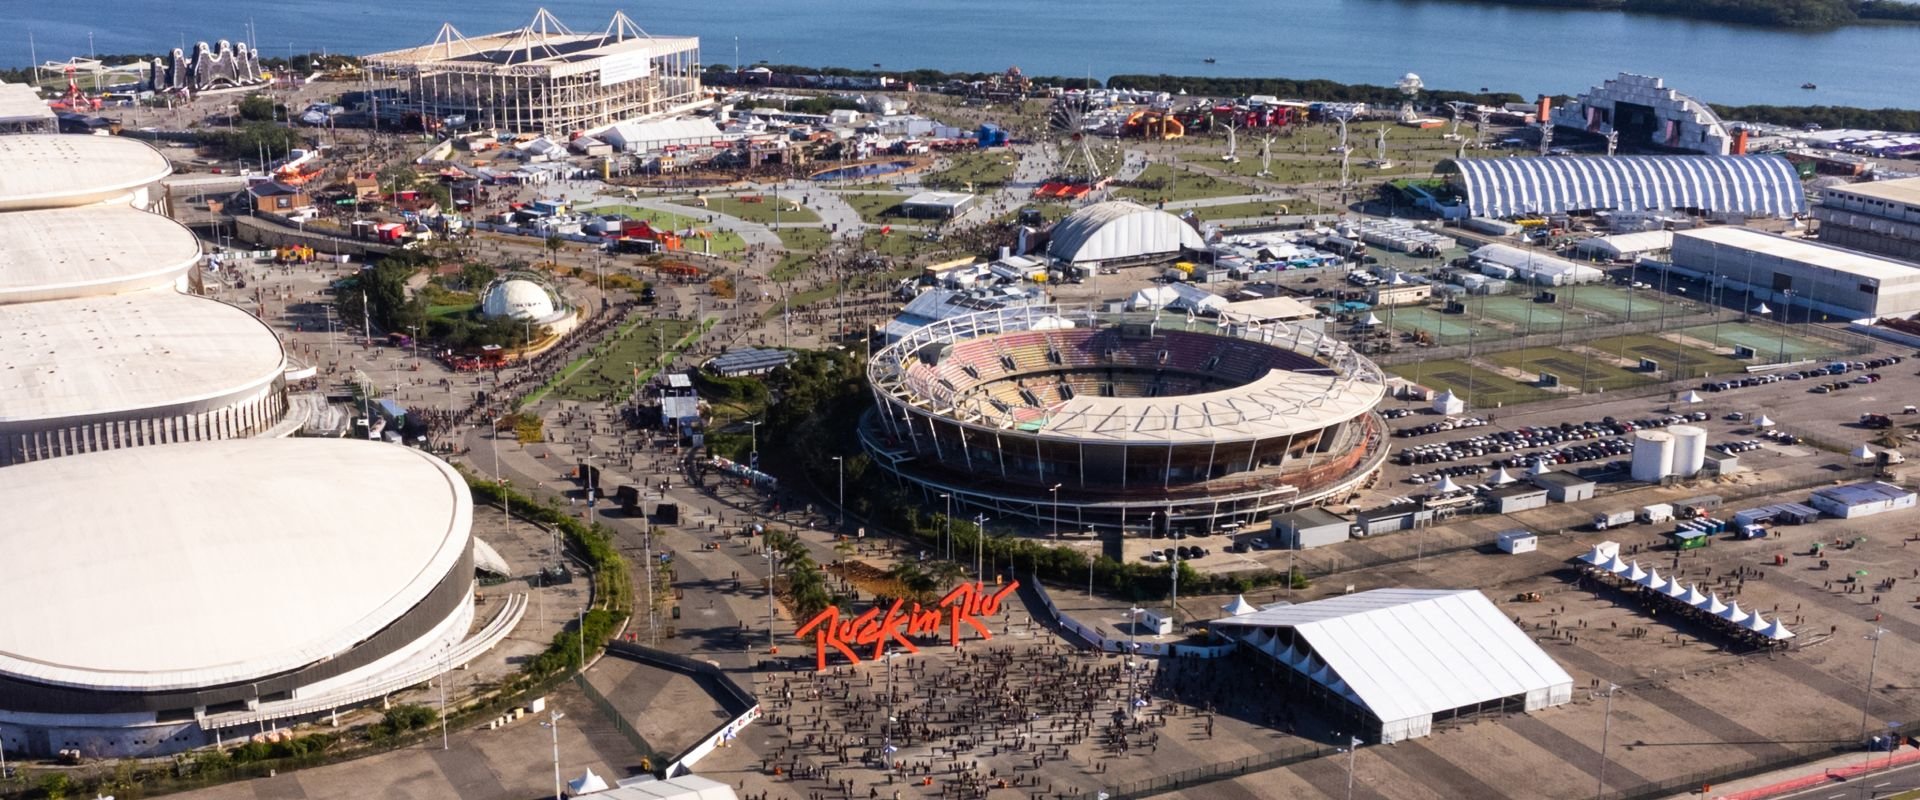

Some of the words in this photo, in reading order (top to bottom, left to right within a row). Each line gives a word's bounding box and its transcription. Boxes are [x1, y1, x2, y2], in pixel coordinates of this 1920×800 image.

[795, 597, 920, 671] Rock
[907, 602, 942, 635] in
[940, 579, 1020, 647] Rio
